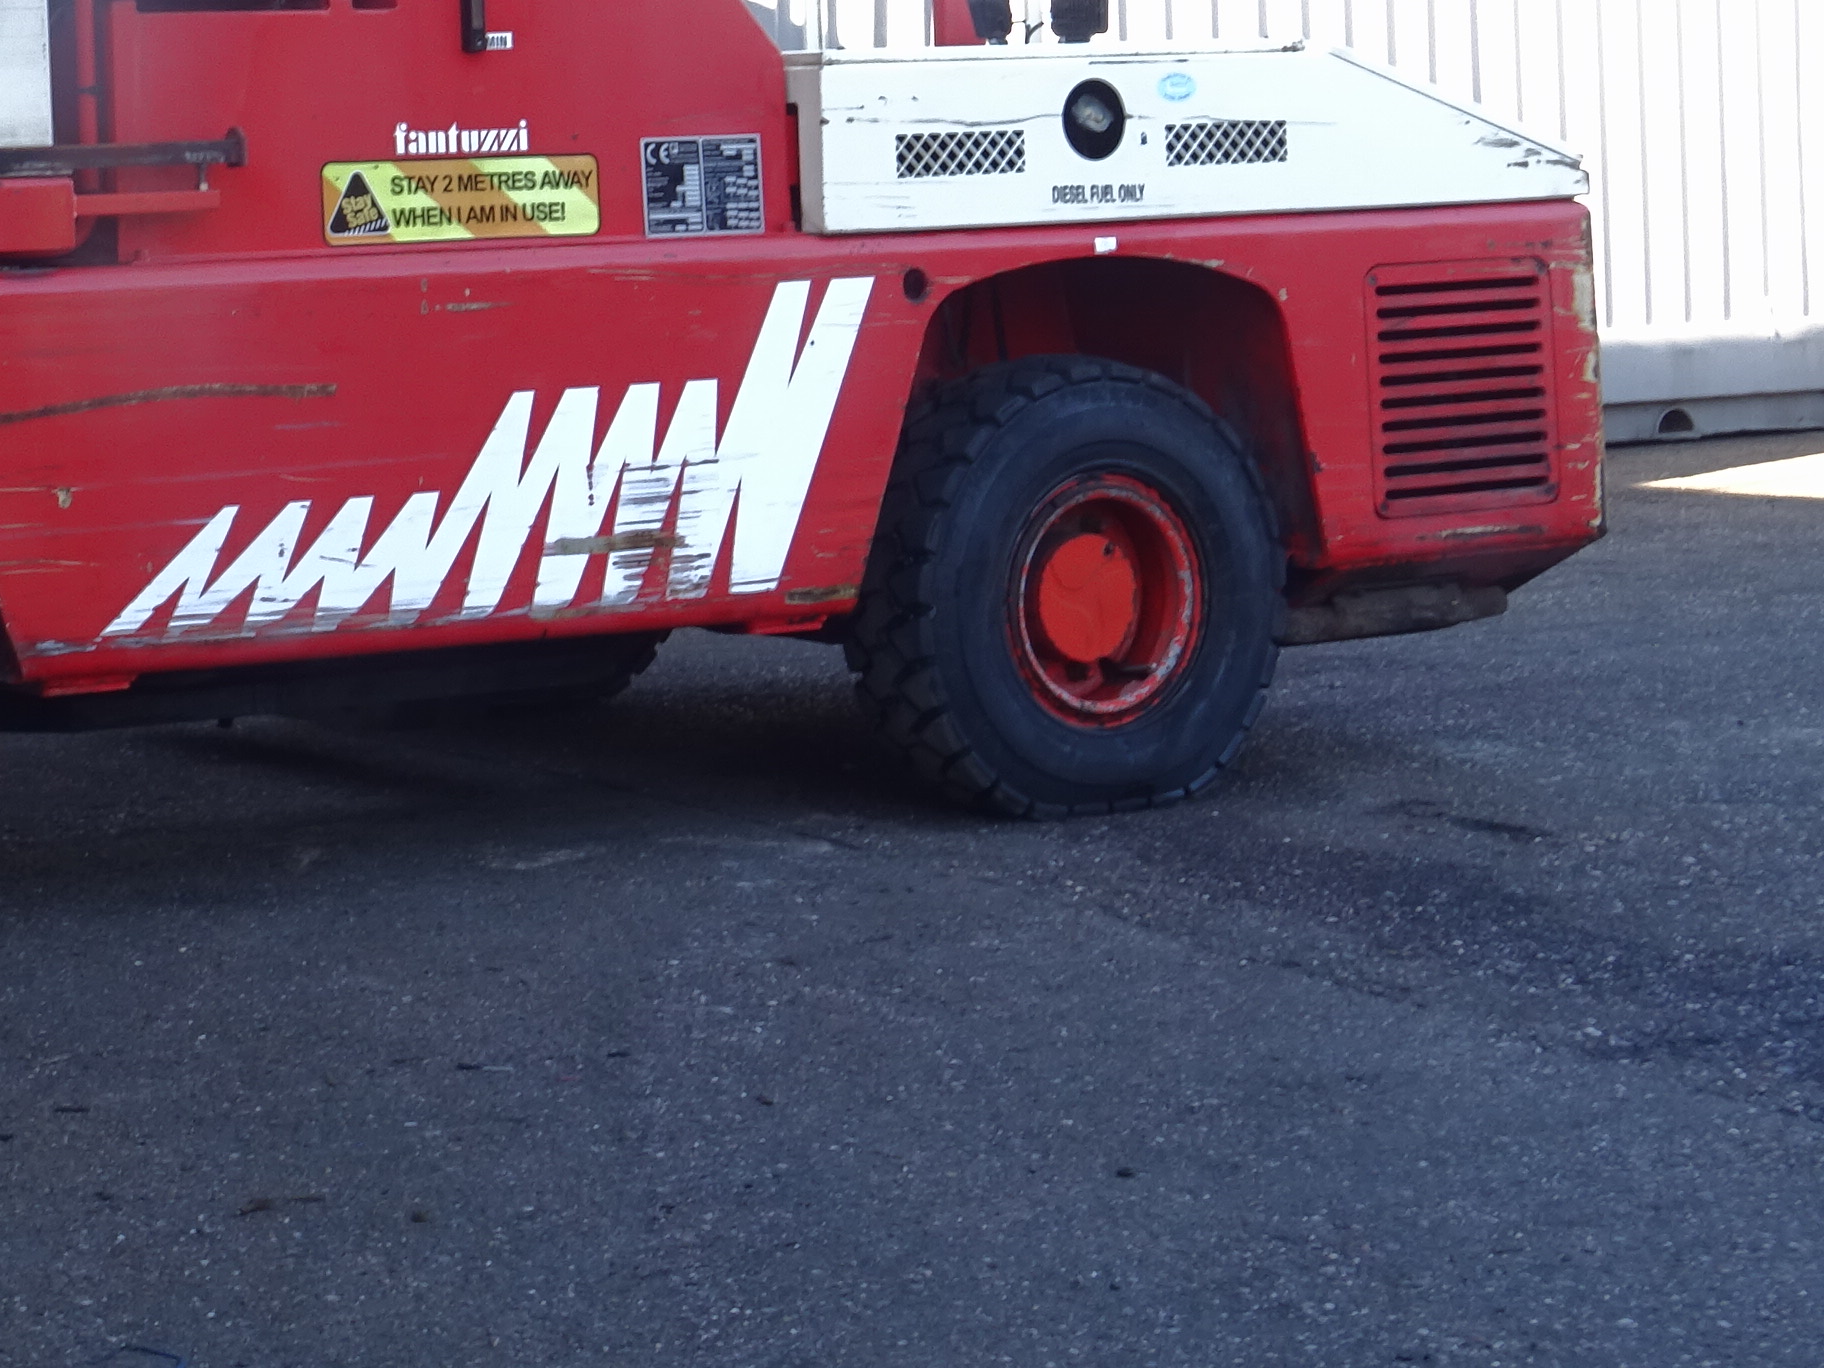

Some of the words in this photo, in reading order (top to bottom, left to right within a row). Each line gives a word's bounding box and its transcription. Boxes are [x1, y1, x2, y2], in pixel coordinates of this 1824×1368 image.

[393, 119, 529, 156] fantuzzi
[390, 174, 438, 196] STAY
[442, 174, 454, 193] 2
[457, 170, 536, 192] METRES
[540, 169, 593, 190] AWAY
[1052, 184, 1088, 204] DIESEL
[1090, 184, 1116, 203] FUEL
[1118, 183, 1145, 203] ONLY
[342, 194, 373, 216] Stay
[392, 205, 452, 228] WHEN
[456, 206, 463, 224] I
[466, 206, 495, 224] AM
[500, 205, 517, 223] IN
[522, 201, 566, 223] USE!
[346, 208, 379, 229] Safe
